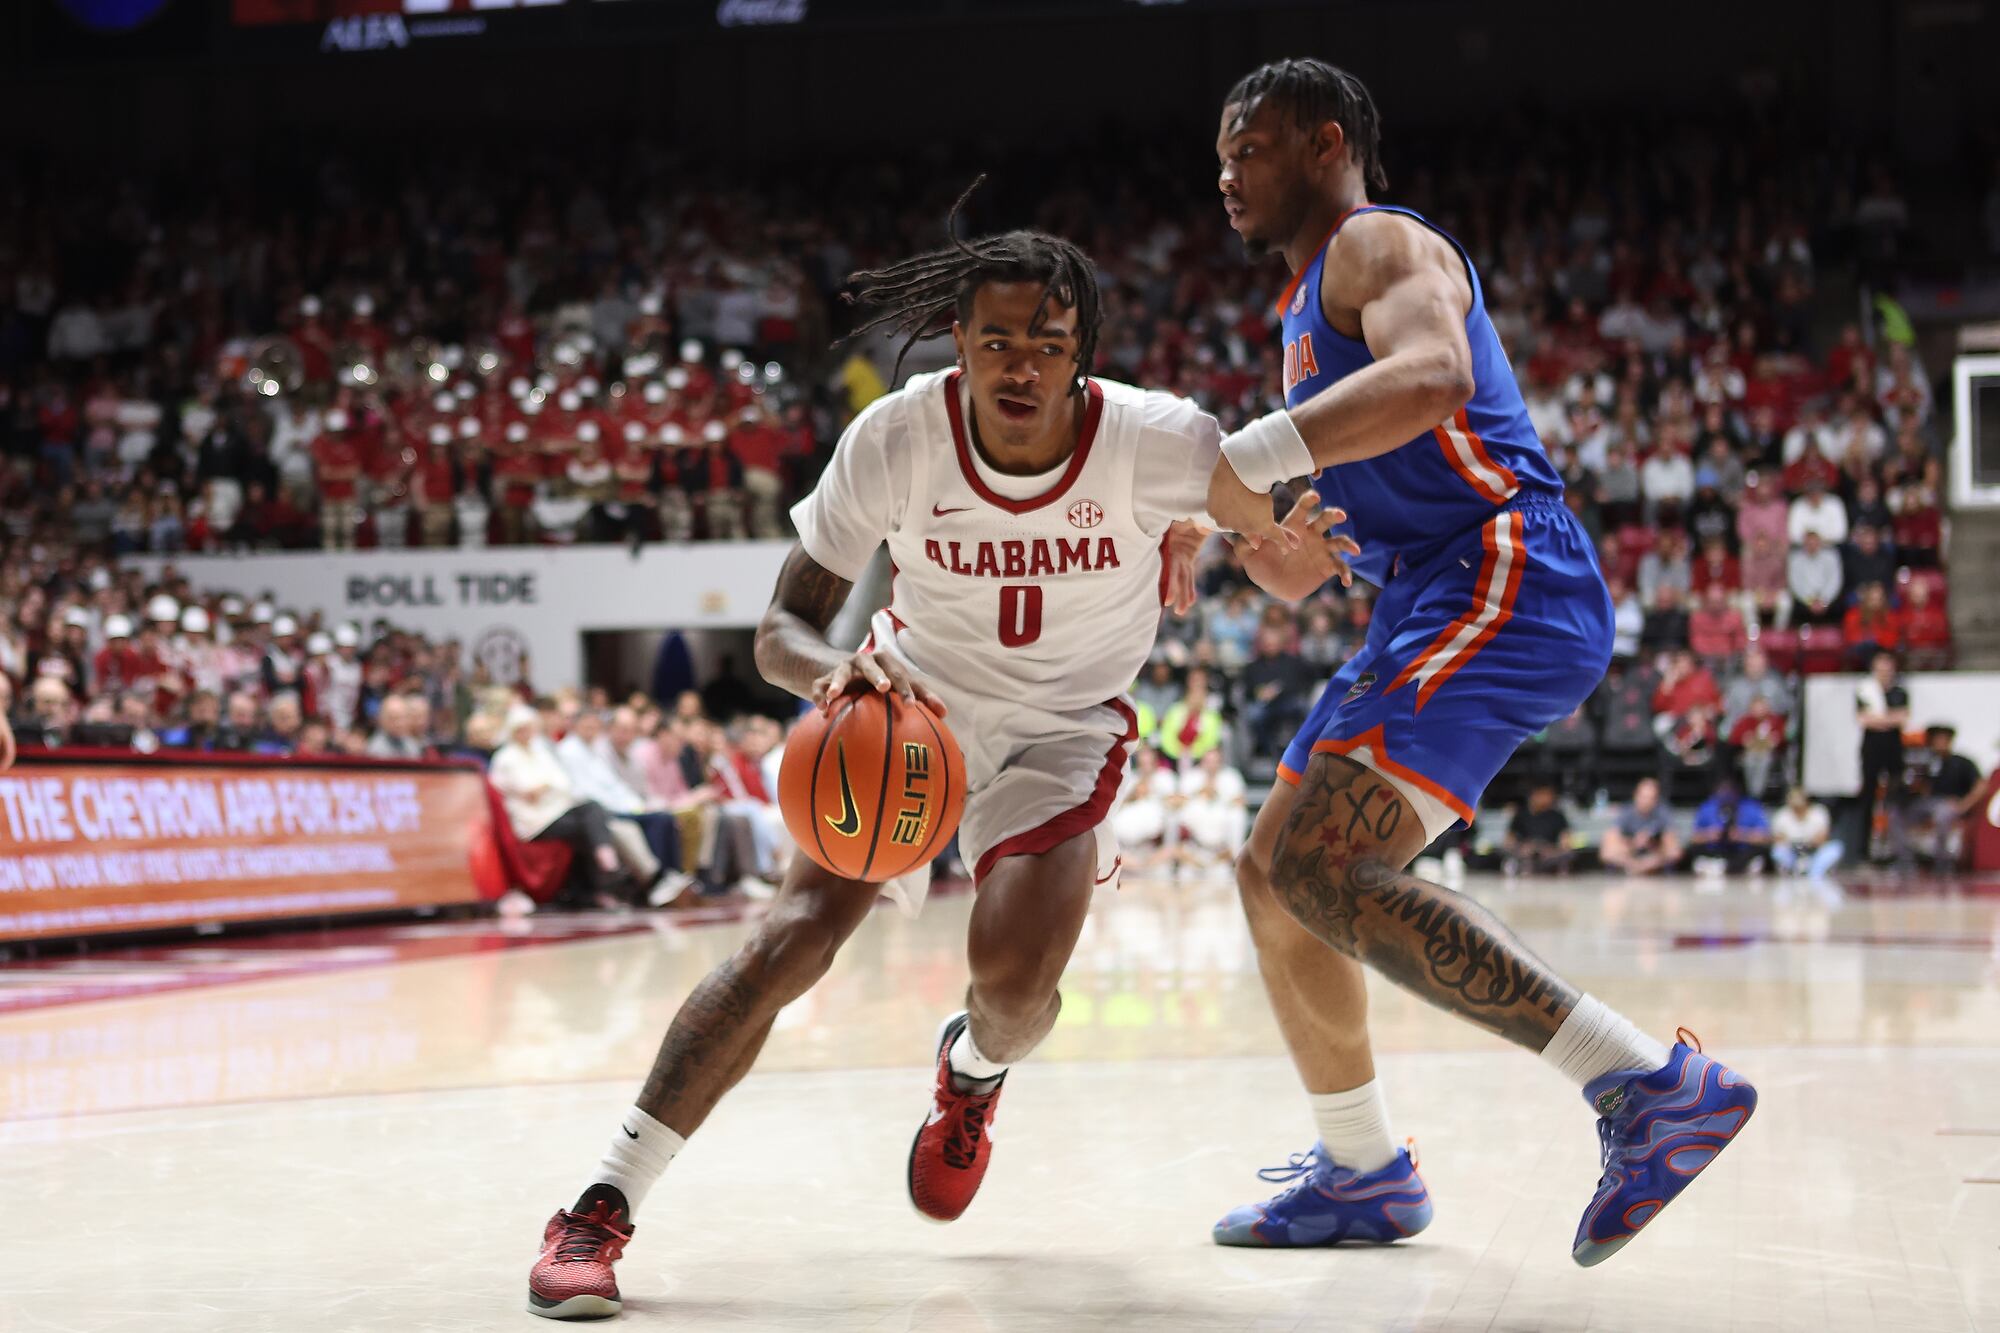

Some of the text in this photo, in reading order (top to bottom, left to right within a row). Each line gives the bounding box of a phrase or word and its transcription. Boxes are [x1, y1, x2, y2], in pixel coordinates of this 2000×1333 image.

[1069, 500, 1103, 528] SEC
[925, 536, 1120, 578] ALABAMA
[346, 571, 536, 604] ROLL TIDE
[998, 585, 1042, 648] 0
[0, 776, 75, 842] THE
[71, 777, 224, 841] CHEVRON
[222, 778, 276, 837] APP
[890, 742, 928, 846] ELITE
